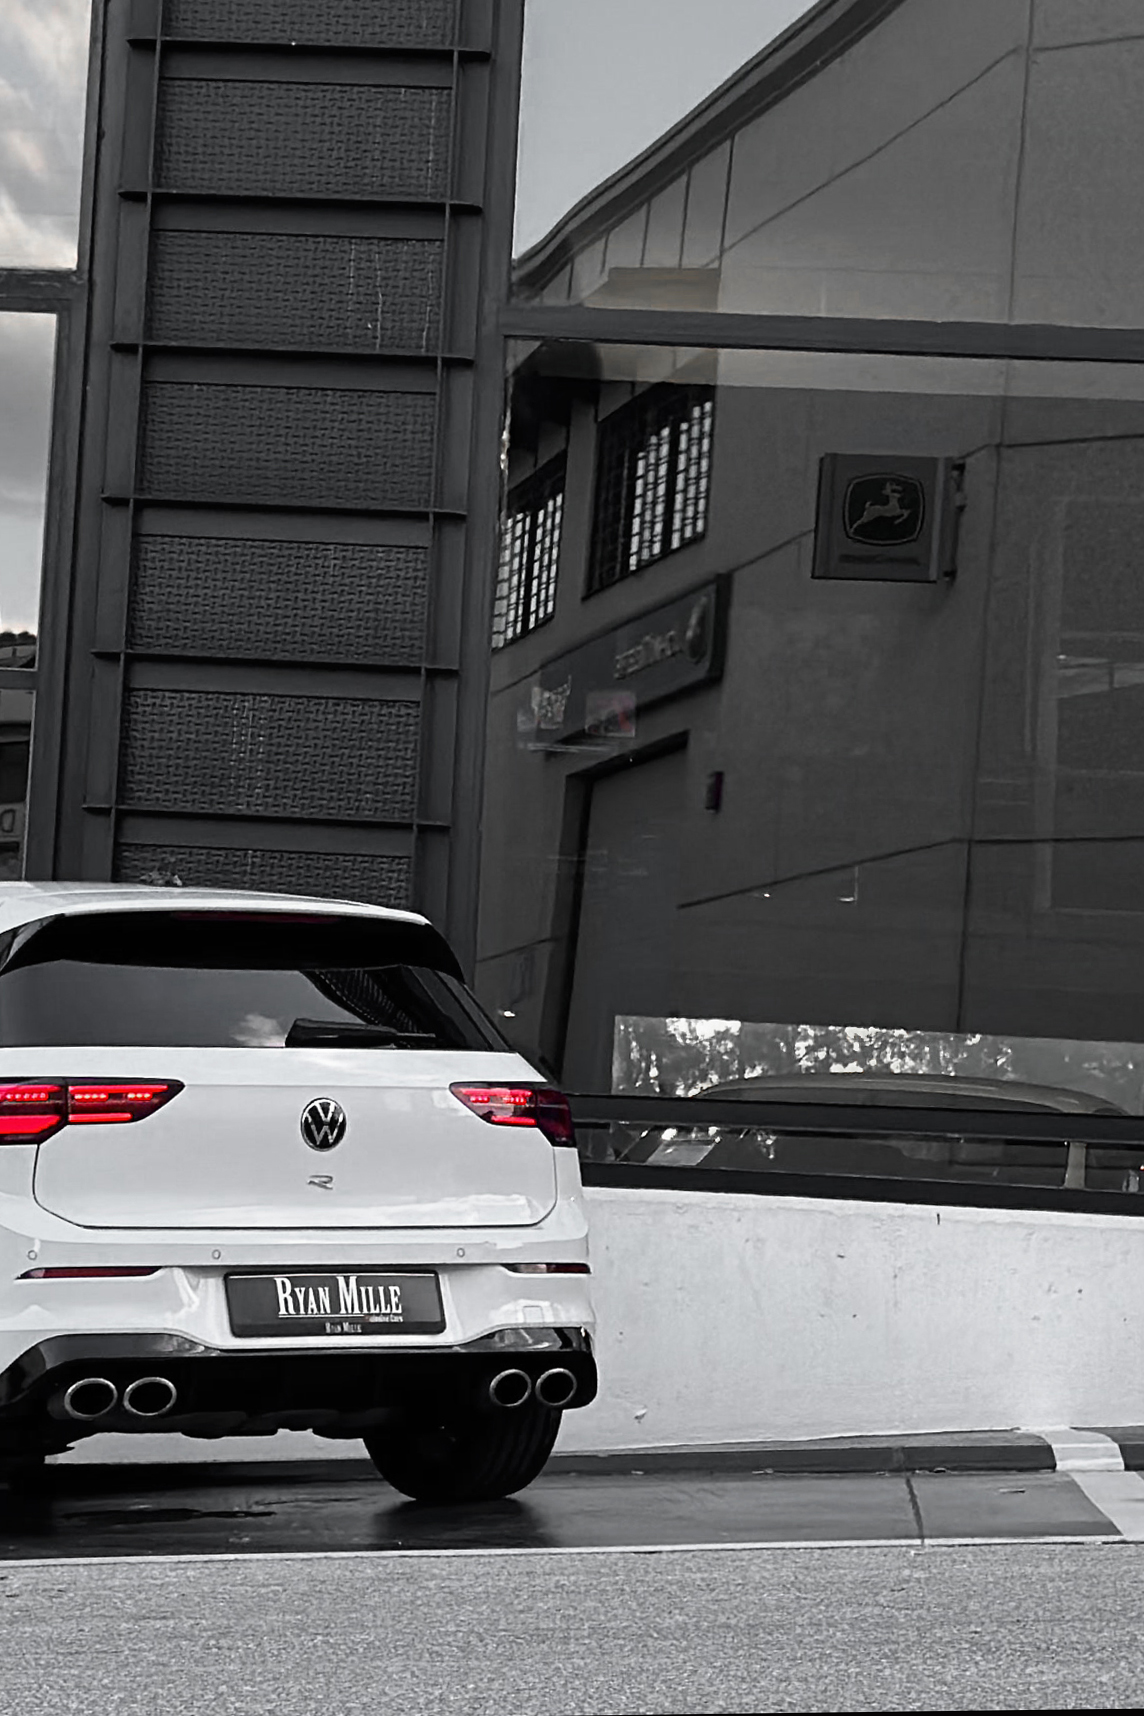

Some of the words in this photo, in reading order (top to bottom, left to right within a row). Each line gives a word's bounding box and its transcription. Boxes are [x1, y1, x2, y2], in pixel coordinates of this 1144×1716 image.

[307, 1175, 334, 1190] R
[274, 1276, 331, 1315] RYAN
[336, 1275, 402, 1315] MILLE
